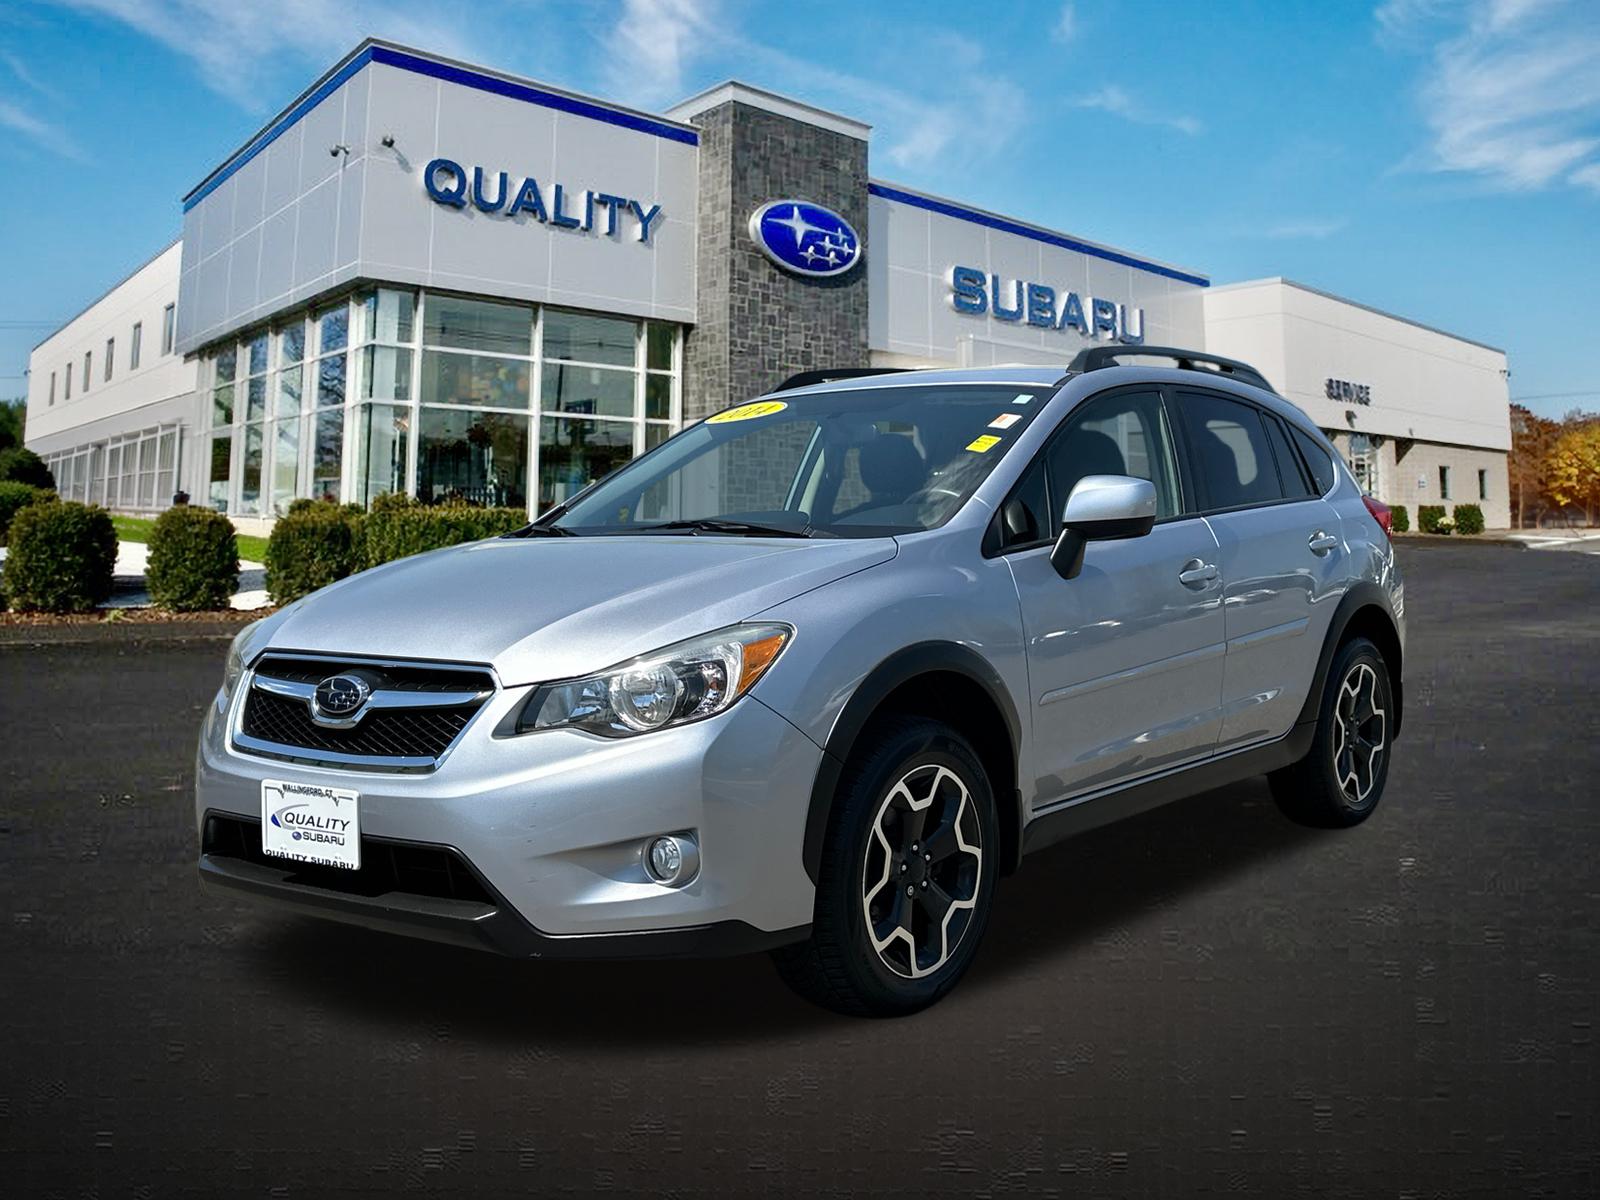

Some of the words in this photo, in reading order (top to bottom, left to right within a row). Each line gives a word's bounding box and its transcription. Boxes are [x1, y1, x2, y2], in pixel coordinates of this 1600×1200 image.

[424, 158, 662, 243] QUALITY
[950, 265, 1145, 345] SUBARU
[284, 811, 350, 831] QUALITY
[302, 831, 345, 846] SUBARU
[265, 848, 307, 862] QUALITY
[310, 856, 354, 869] SUBARU
